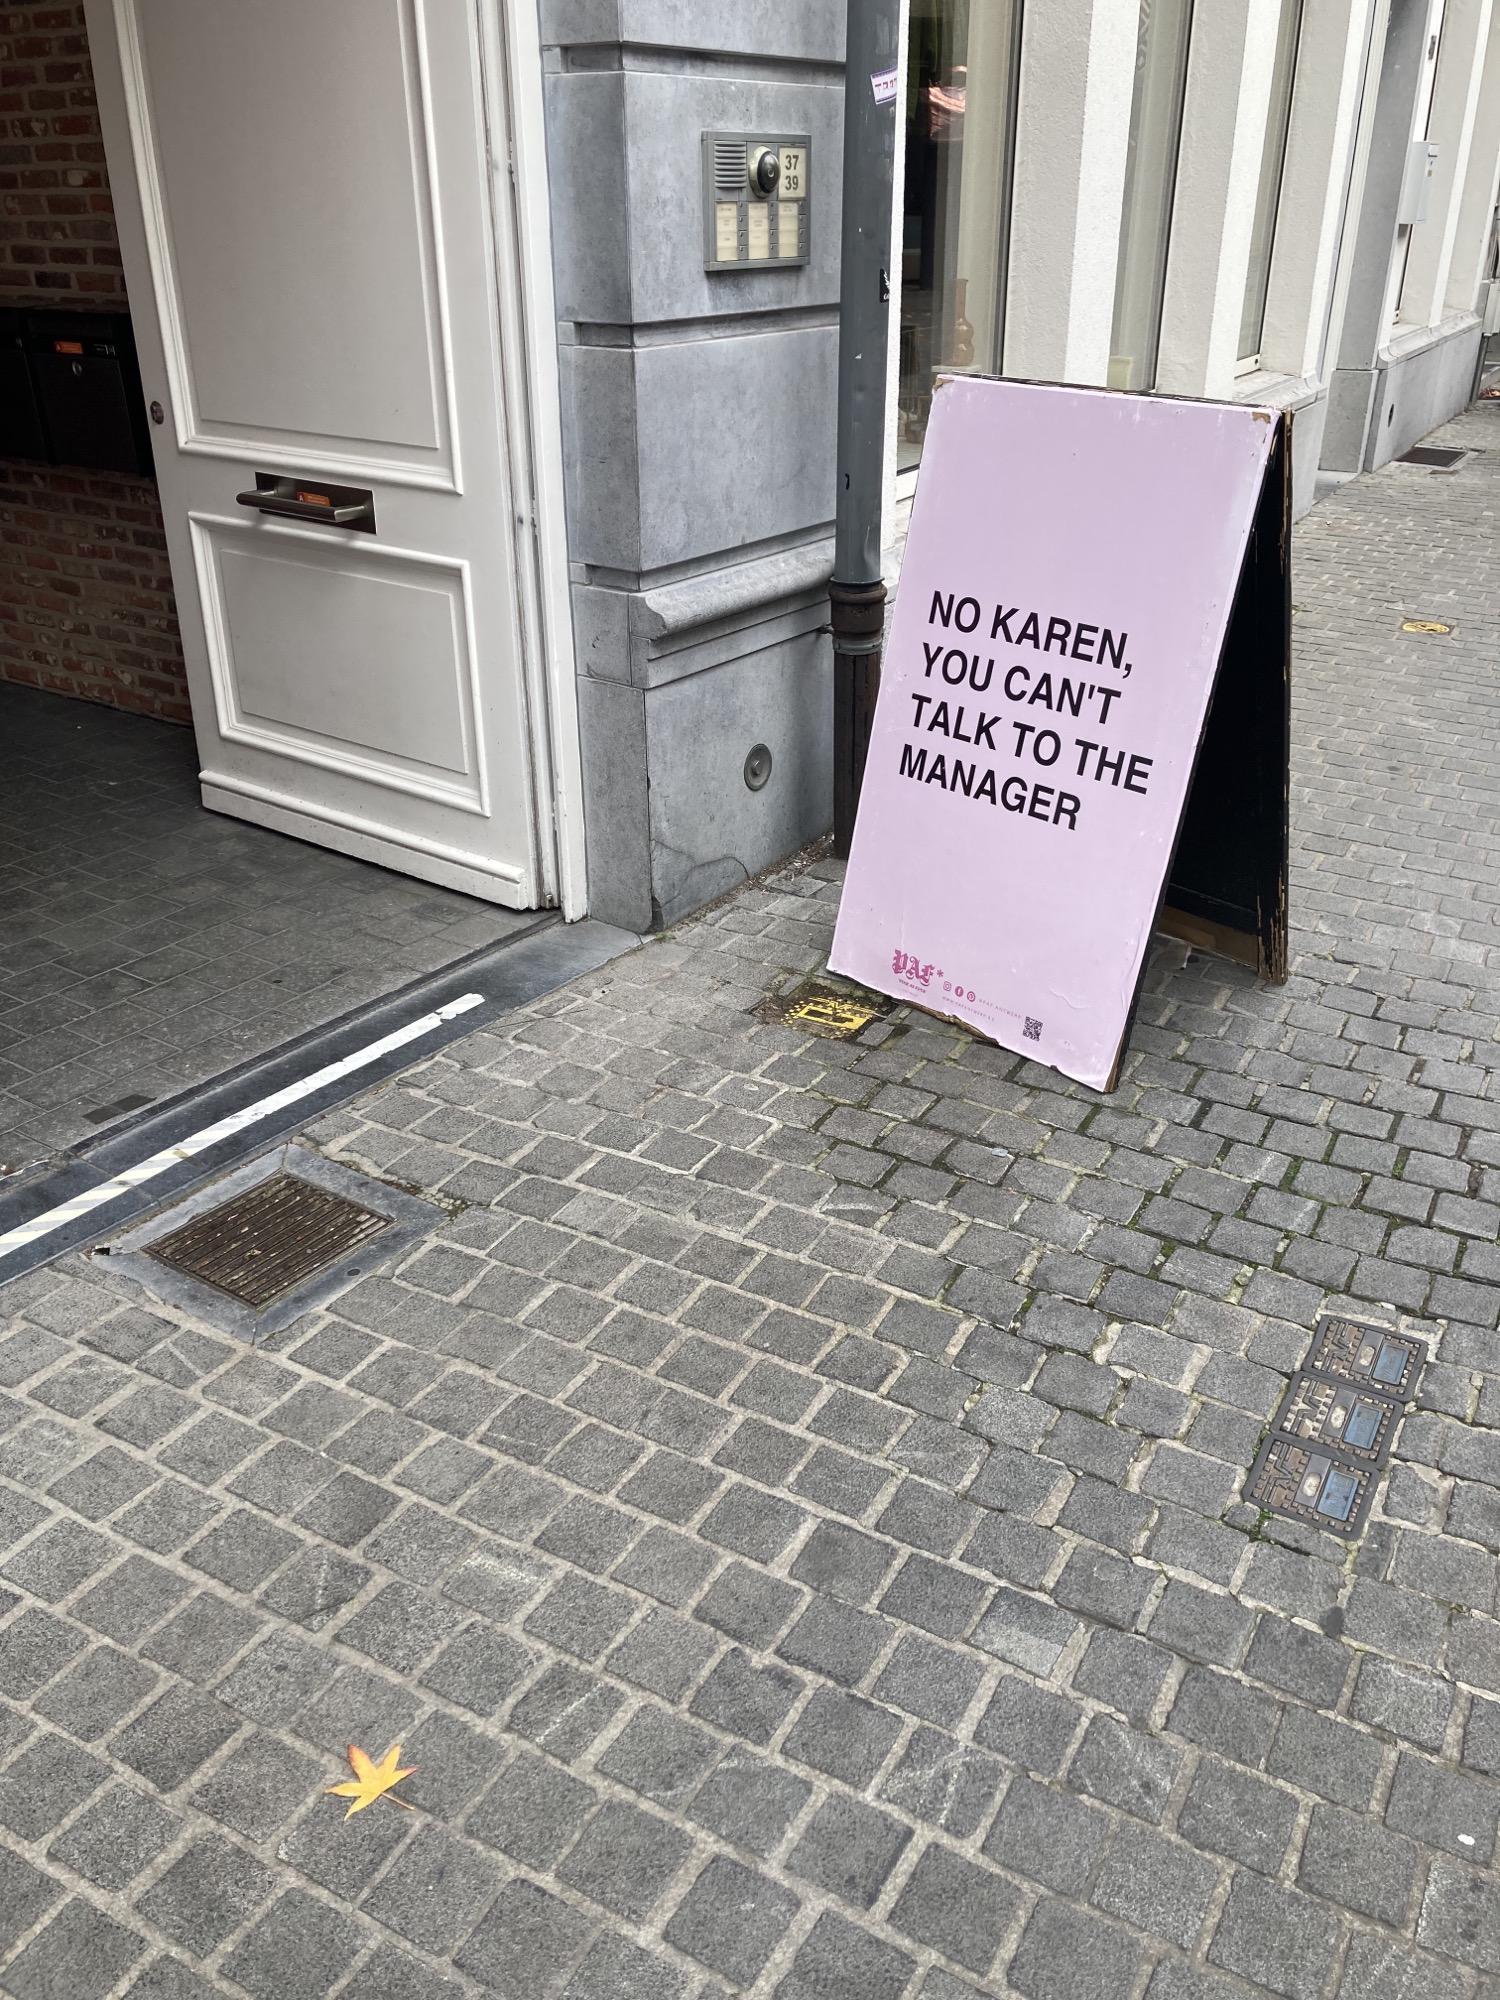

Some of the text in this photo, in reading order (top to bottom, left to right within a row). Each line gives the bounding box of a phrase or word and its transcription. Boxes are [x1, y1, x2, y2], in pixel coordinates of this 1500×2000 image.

[785, 154, 800, 171] 37
[785, 175, 799, 191] 39
[928, 590, 1133, 679] NO KAREN,
[922, 642, 1122, 725] YOU CAN'T
[911, 692, 1154, 795] TALK TO THE
[899, 743, 1081, 831] MANAGER
